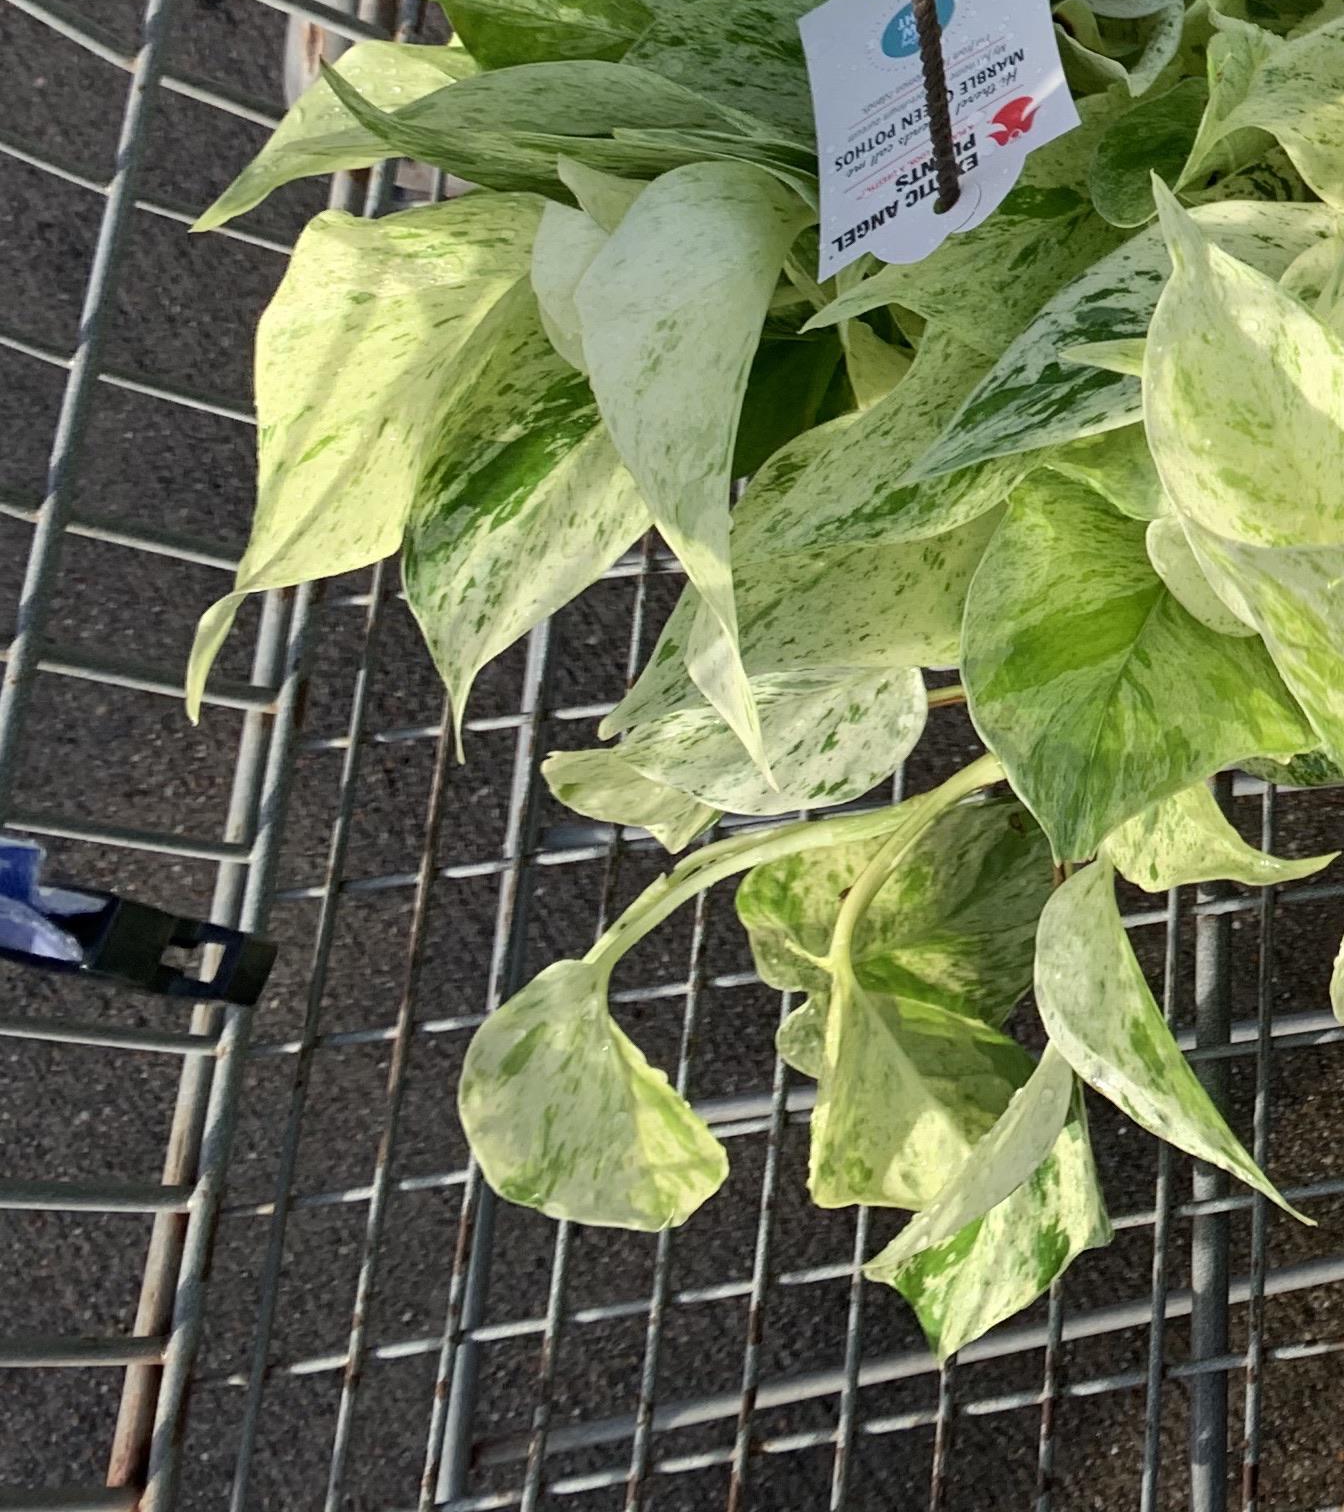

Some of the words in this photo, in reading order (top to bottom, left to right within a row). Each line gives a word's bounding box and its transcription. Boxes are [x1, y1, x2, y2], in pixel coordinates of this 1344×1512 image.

[958, 46, 1024, 97] MARBLE
[834, 123, 895, 171] POTHOS
[895, 132, 975, 193] PLNTS
[904, 151, 978, 208] EXTIC
[831, 199, 899, 255] ANGEL
